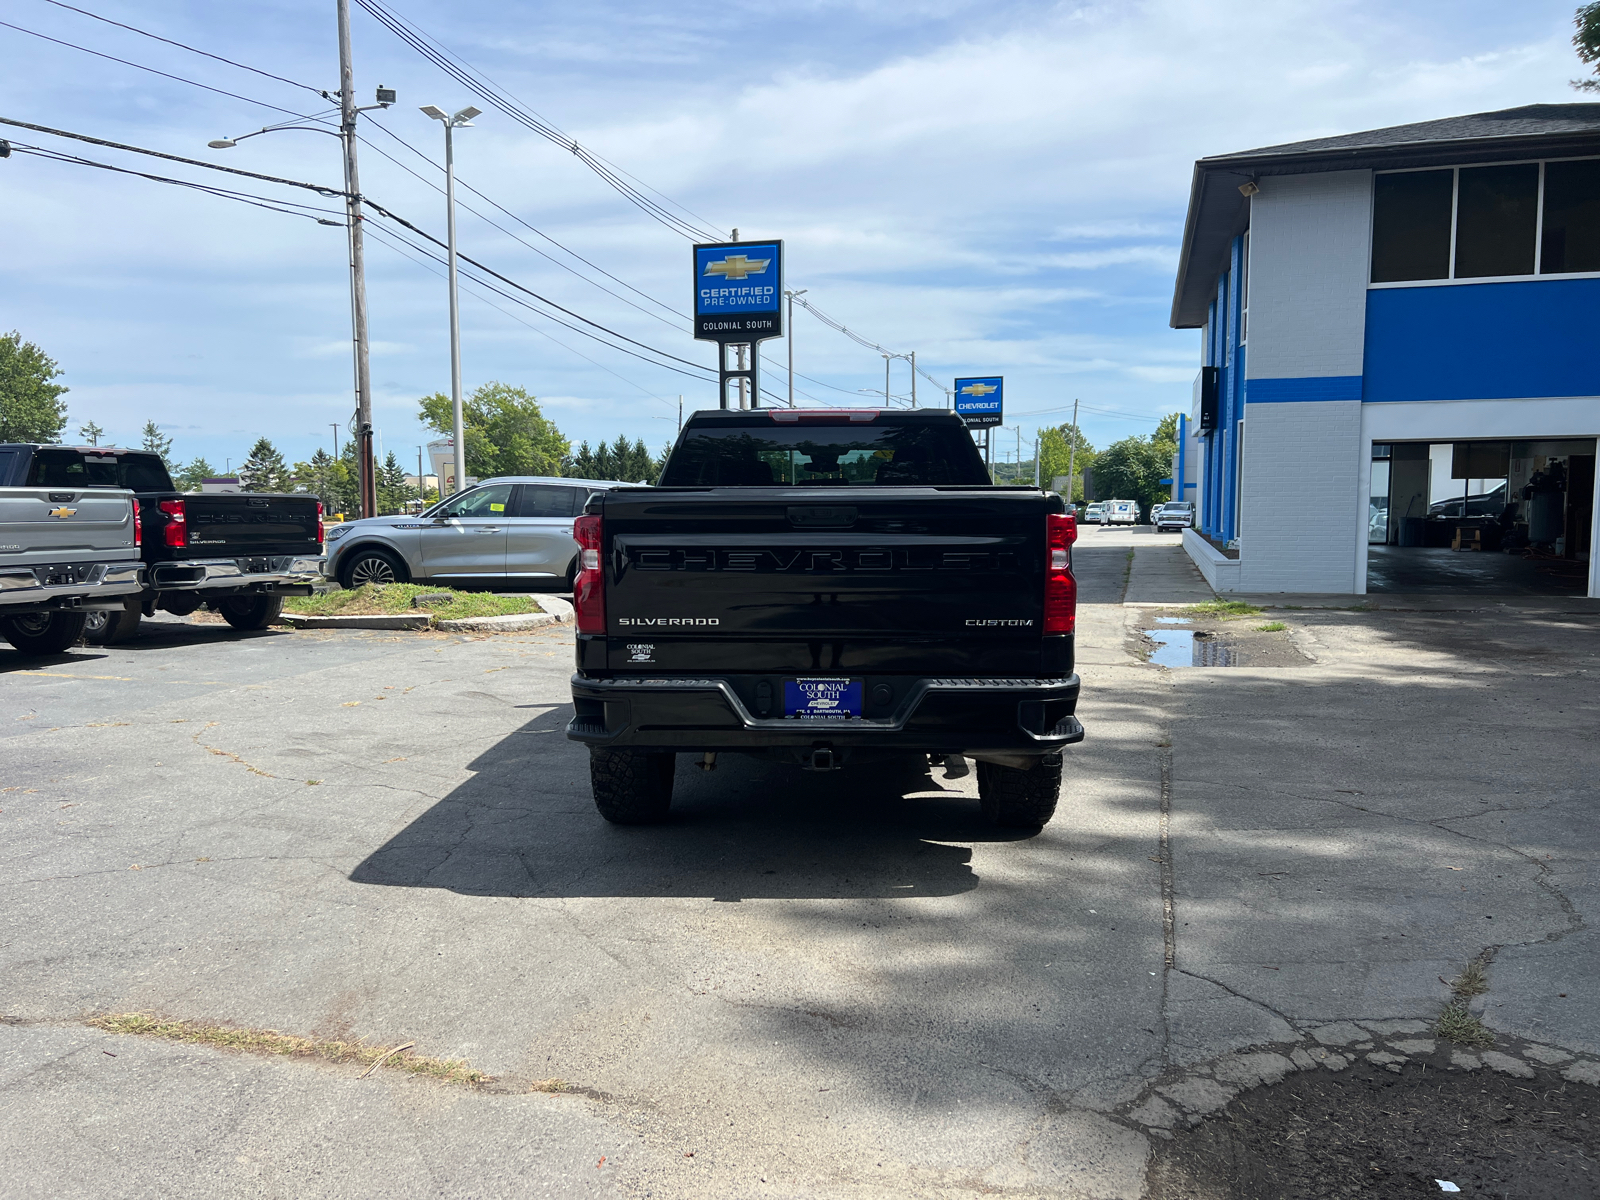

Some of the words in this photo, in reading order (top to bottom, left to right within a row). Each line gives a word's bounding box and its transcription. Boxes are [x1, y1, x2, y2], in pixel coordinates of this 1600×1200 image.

[700, 286, 774, 297] CERTIFIED
[704, 295, 770, 306] PRE-OWNED
[703, 321, 742, 331] COLONIAL
[746, 320, 772, 329] SOUTH
[958, 402, 999, 410] CHEVROLET
[634, 550, 1014, 571] CHEVROLET
[618, 617, 720, 626] SILVERADO
[965, 618, 1034, 627] CUSTOM
[799, 683, 847, 691] COLONIAL
